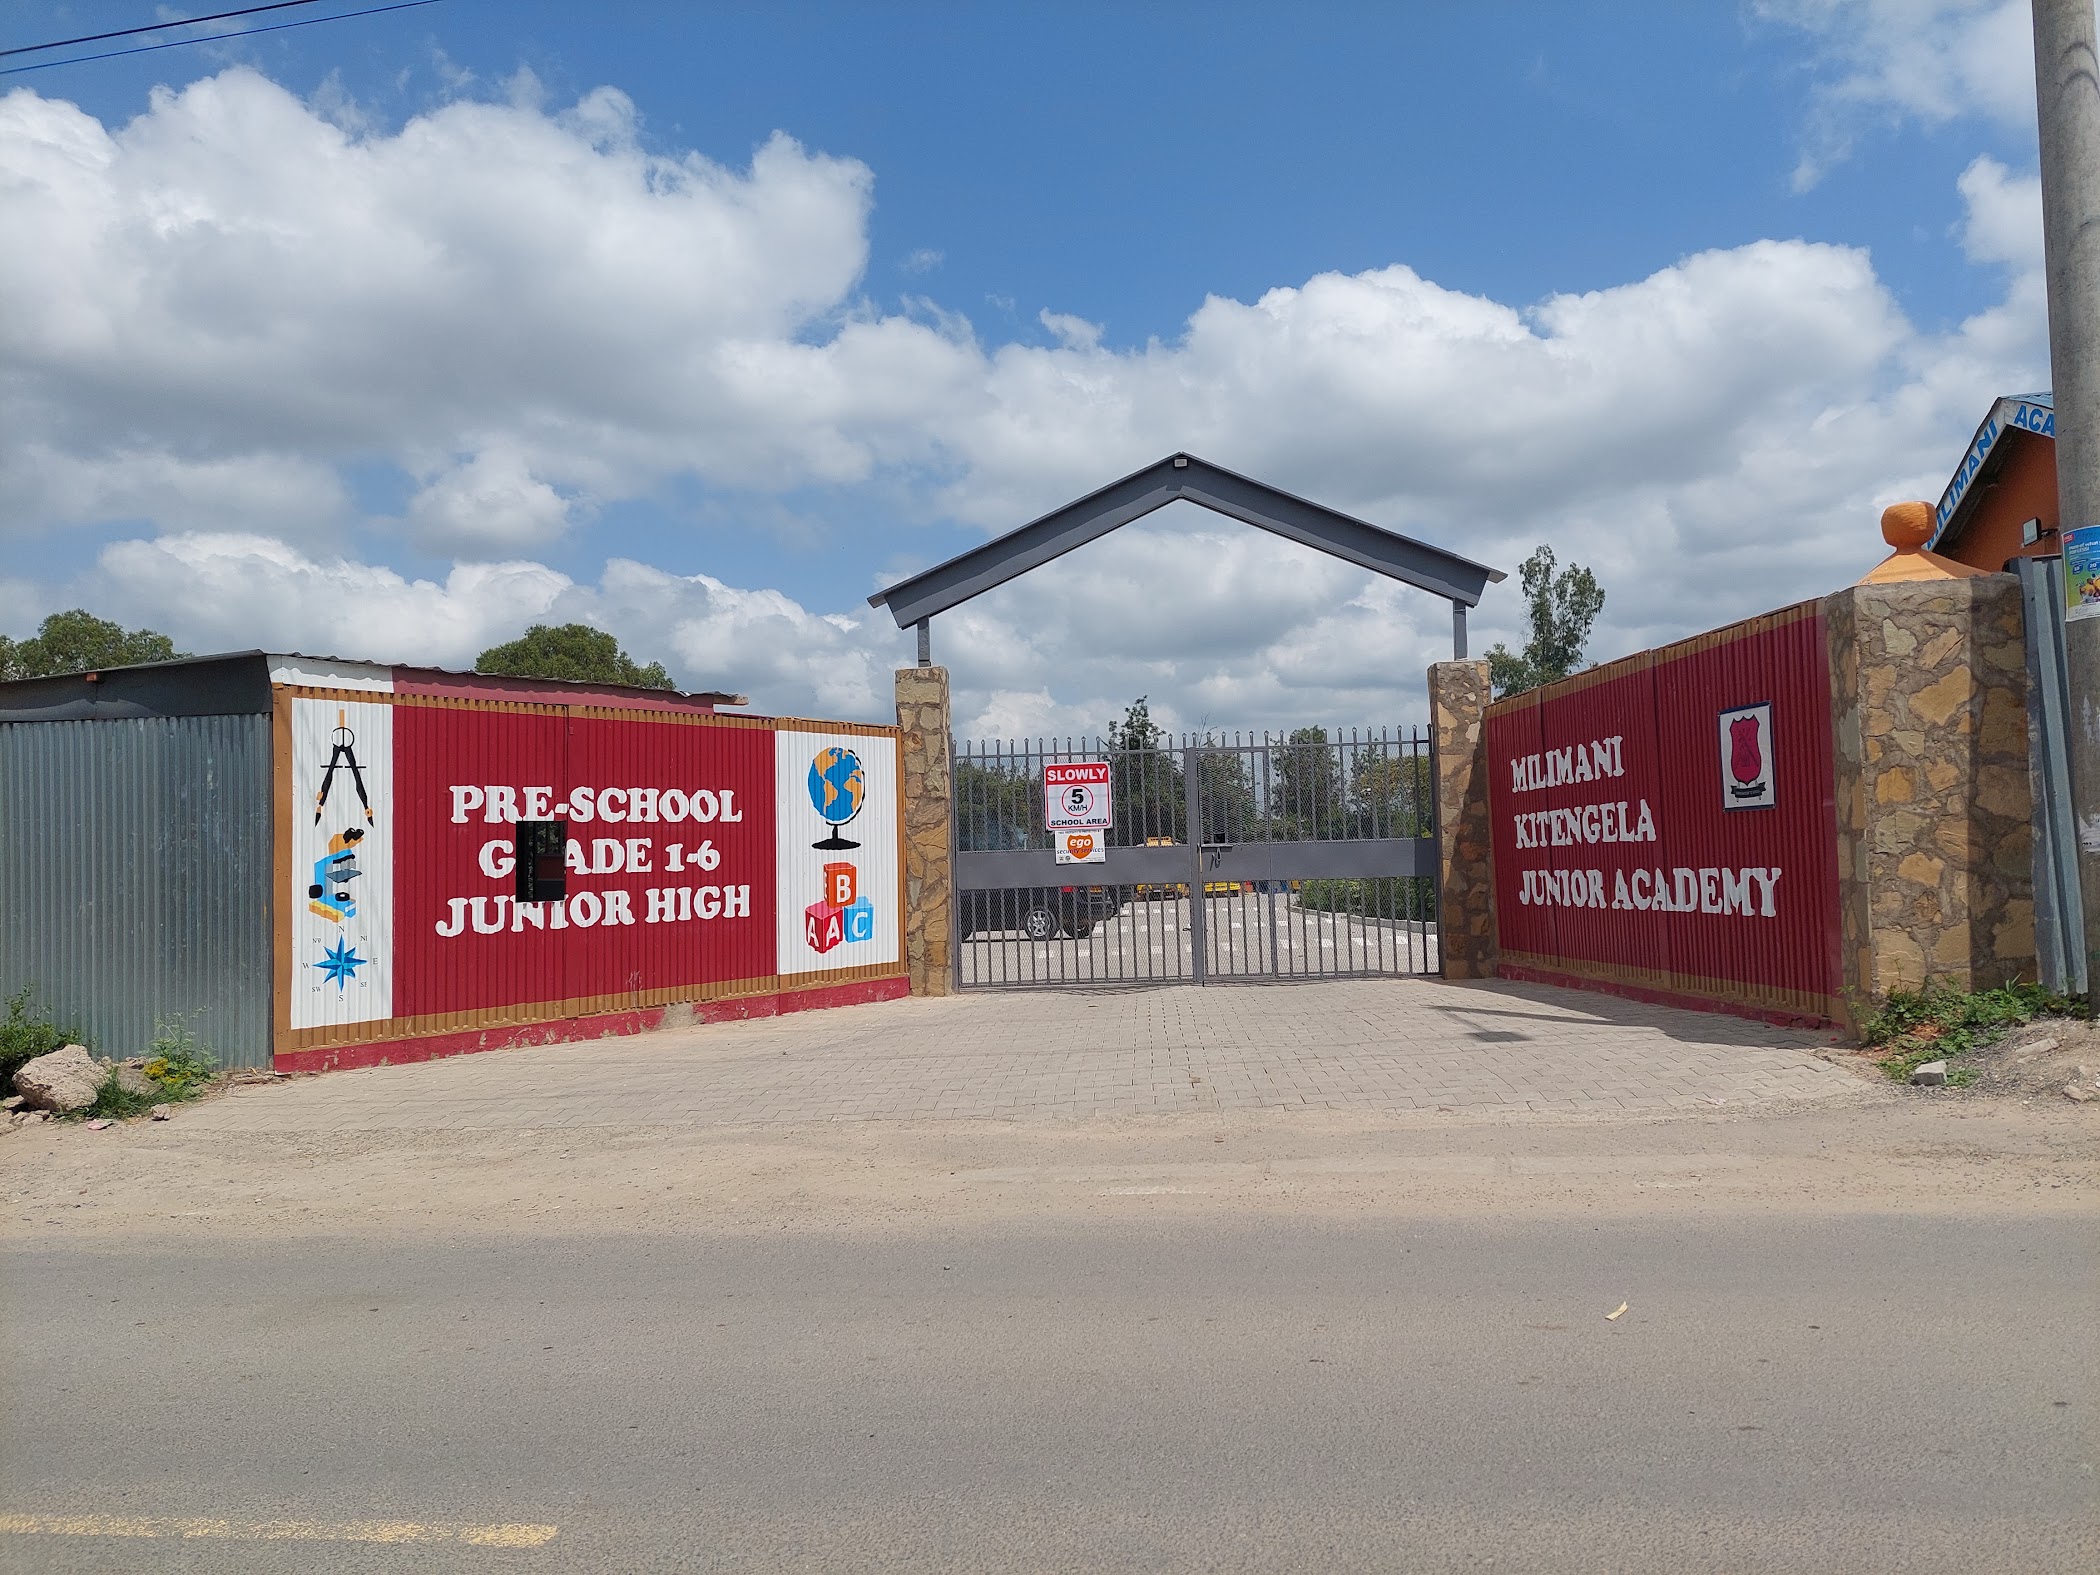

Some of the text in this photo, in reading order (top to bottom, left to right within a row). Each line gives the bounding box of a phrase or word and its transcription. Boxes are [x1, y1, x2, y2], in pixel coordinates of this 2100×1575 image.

[1047, 767, 1106, 782] SLOWLY
[1511, 735, 1626, 793] MILIMANI
[449, 785, 742, 824] PRE-SCHOOL
[1068, 804, 1088, 812] KM/H
[1071, 788, 1084, 804] 5
[1515, 798, 1657, 849] KITENGELA
[478, 837, 721, 878] GADE 1-6
[1069, 838, 1091, 848] ego
[836, 874, 852, 904] B
[1519, 866, 1782, 918] JUNIOR ACADEMY
[435, 884, 750, 937] JUNIOR HIGH
[852, 911, 869, 938] C
[807, 916, 820, 947] A
[826, 915, 840, 947] A
[372, 957, 378, 965] E
[338, 994, 344, 1002] S
